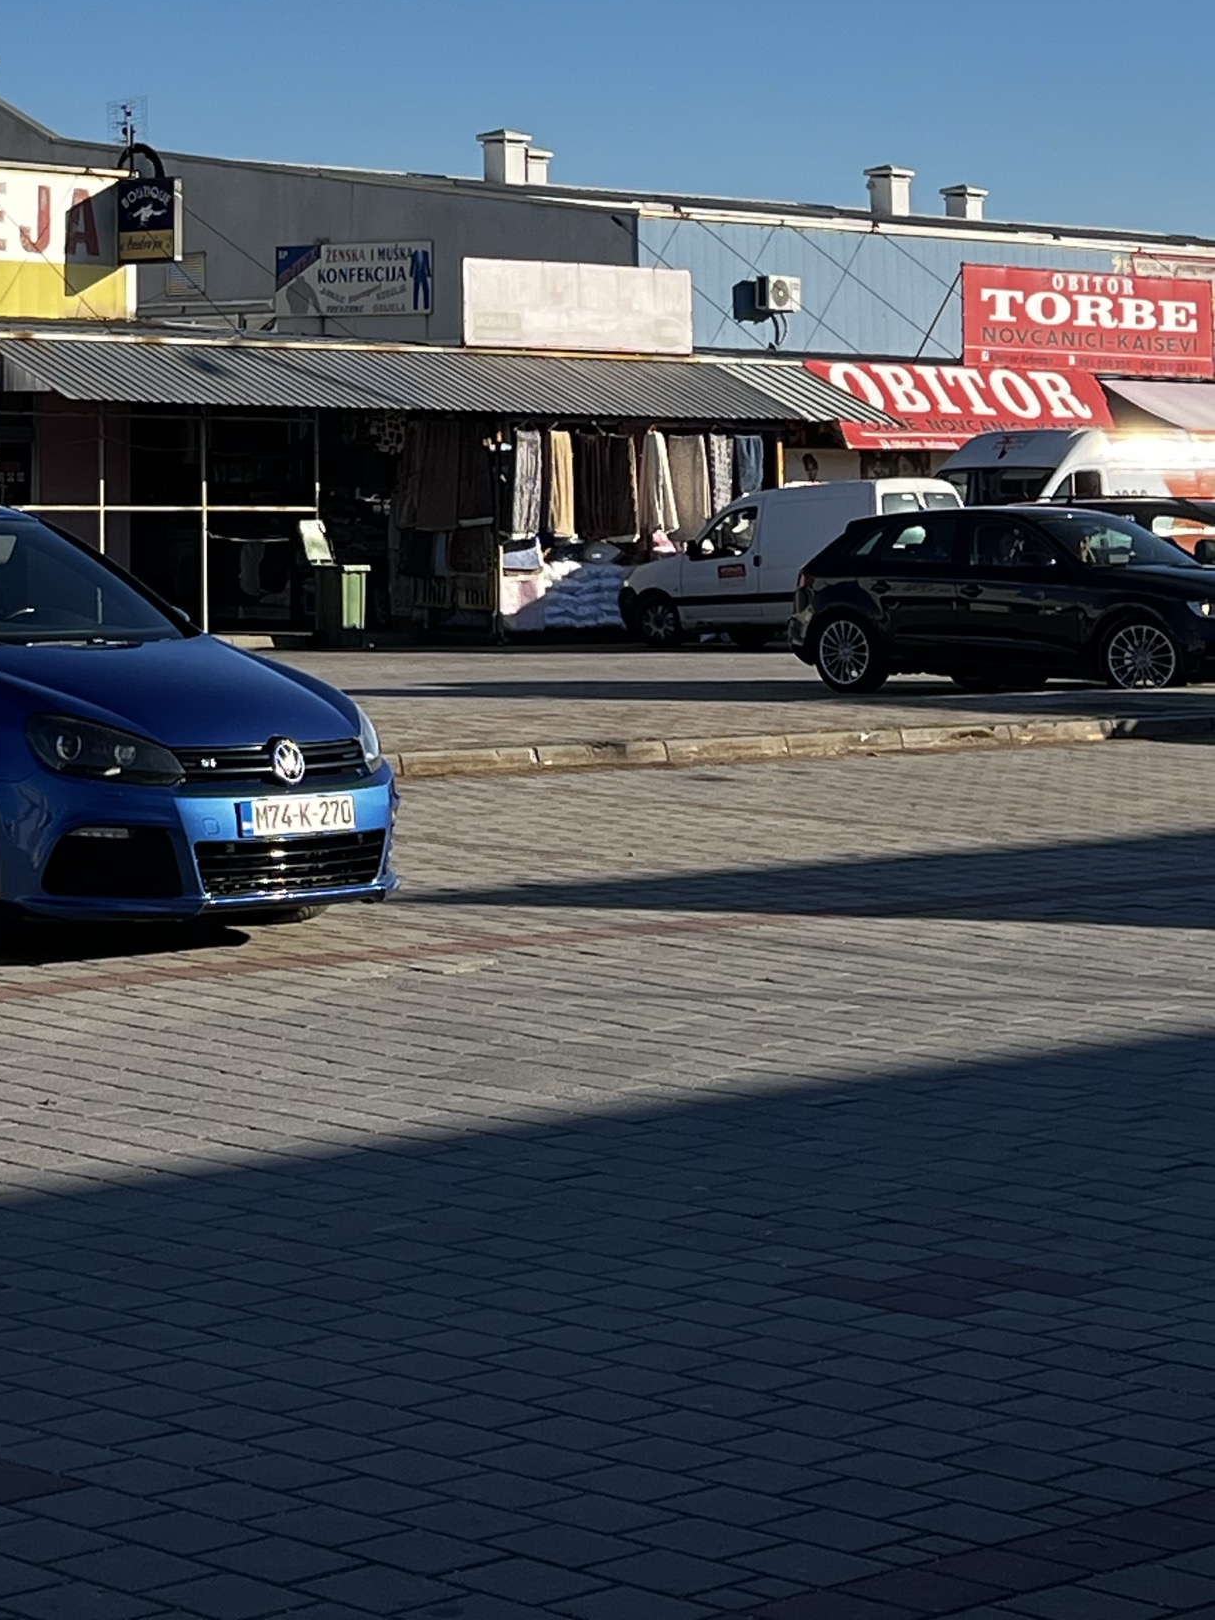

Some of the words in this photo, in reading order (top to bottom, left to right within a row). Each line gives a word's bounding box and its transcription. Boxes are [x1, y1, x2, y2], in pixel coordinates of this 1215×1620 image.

[325, 247, 366, 264] ŽENSKA
[317, 265, 407, 284] KONFEKCIJA
[1052, 273, 1135, 296] OBITOR
[980, 288, 1198, 334] TORBE
[829, 362, 1093, 421] OBITOR
[254, 799, 352, 830] M74-K-270
